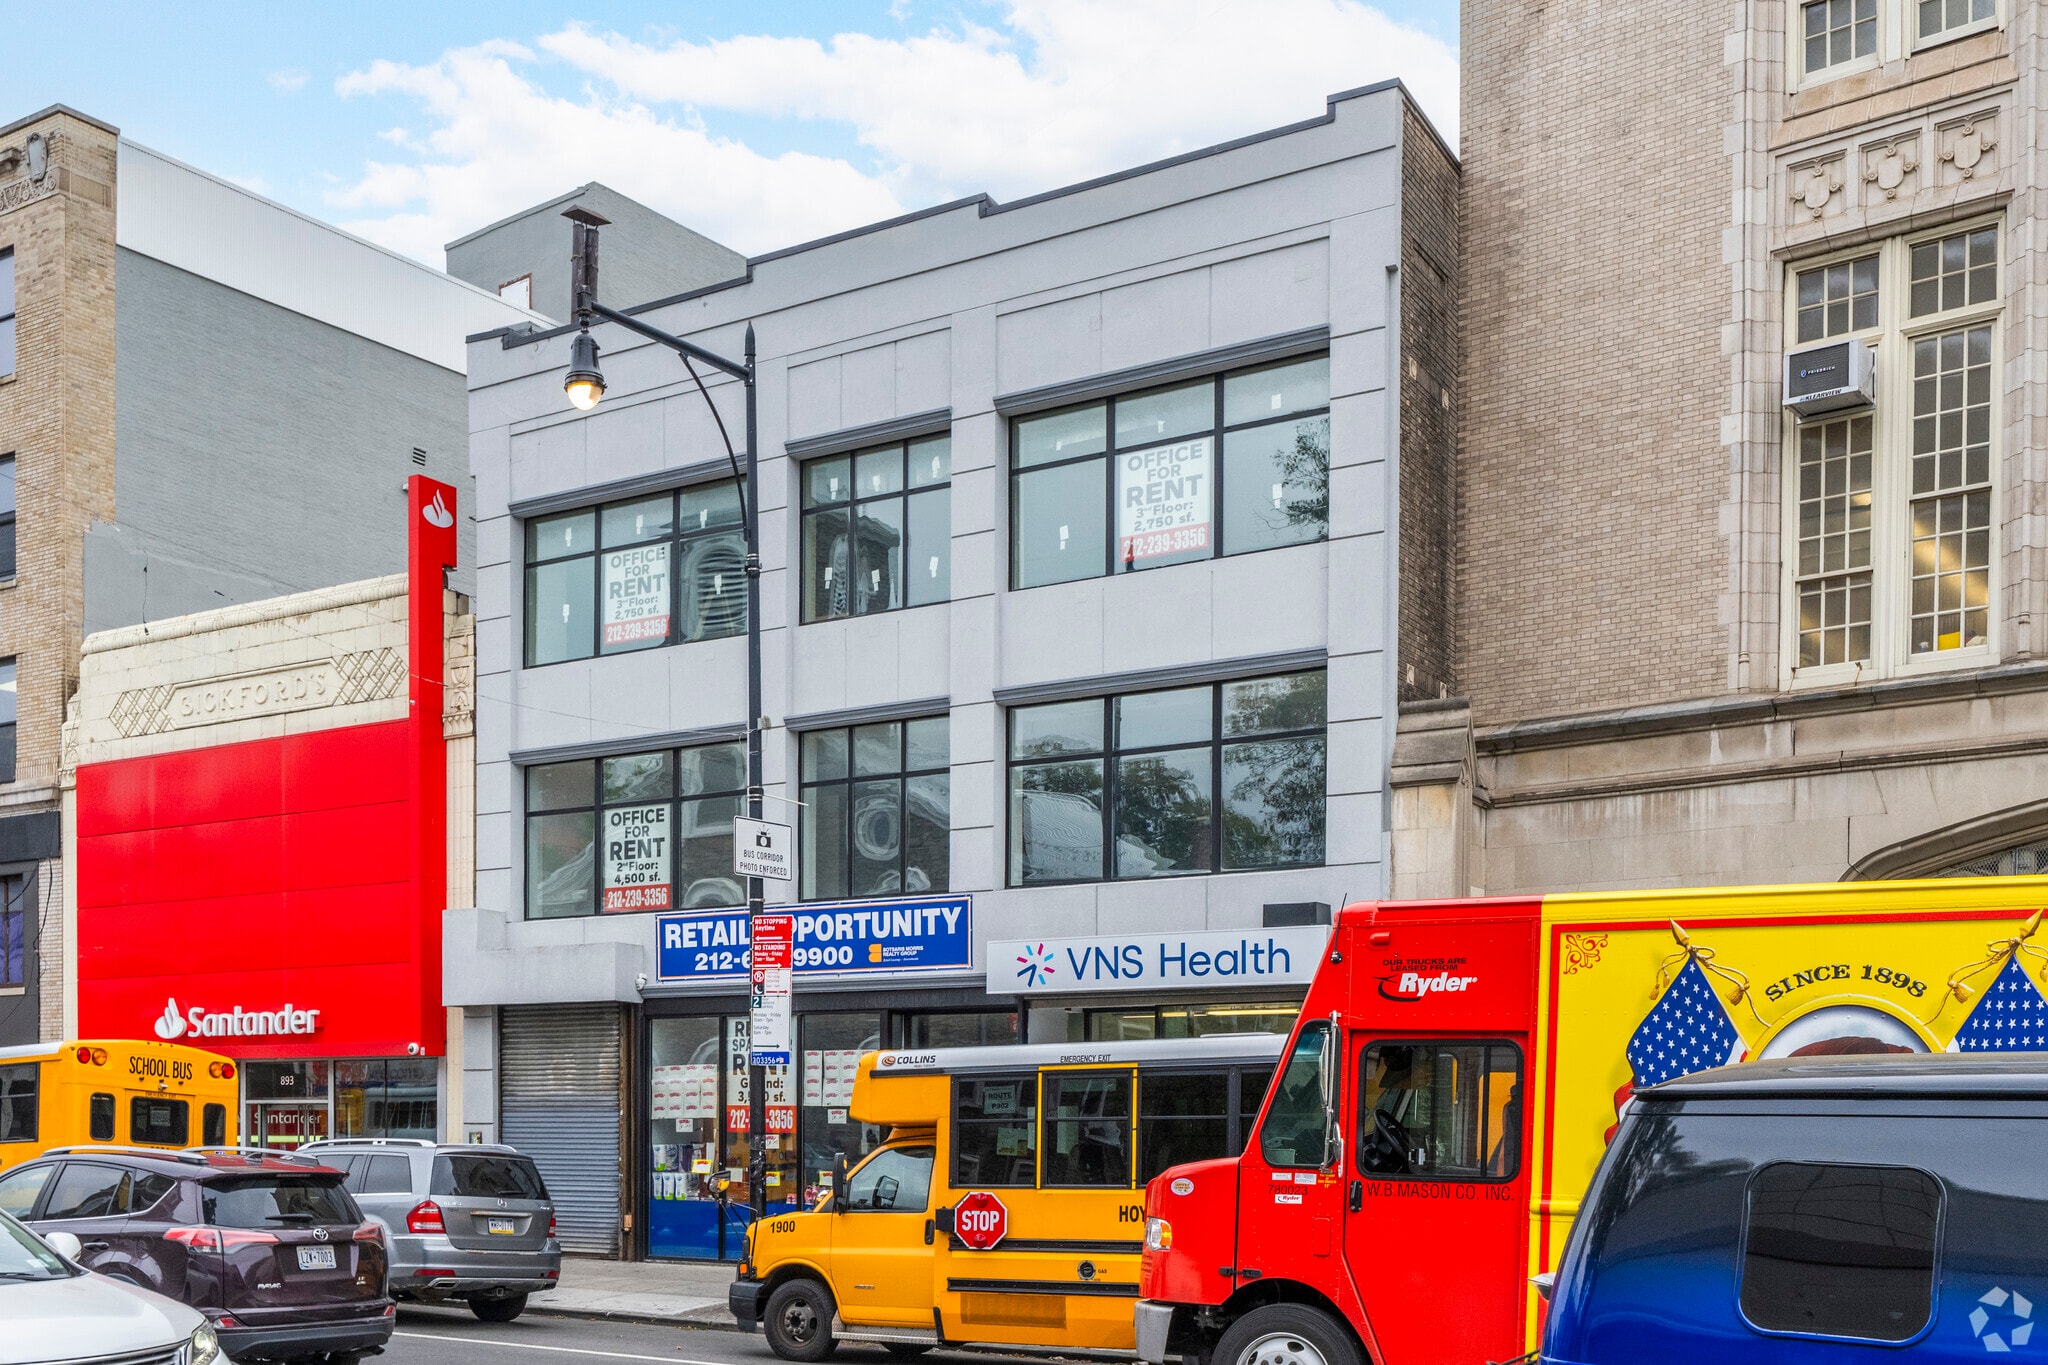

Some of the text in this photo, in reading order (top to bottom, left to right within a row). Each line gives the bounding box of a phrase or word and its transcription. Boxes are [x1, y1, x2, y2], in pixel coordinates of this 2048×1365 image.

[1808, 366, 1836, 374] FRIEDRICH
[1806, 389, 1842, 400] KLEARVIEW
[1127, 443, 1203, 472] OFFICE
[1147, 464, 1181, 482] FOR
[1126, 474, 1203, 508] RENT
[1153, 501, 1194, 516] Floor:
[1134, 511, 1196, 532] 2,750 sf.
[1123, 527, 1206, 559] 212-239-3356
[610, 547, 666, 569] OFFICE
[625, 564, 650, 578] FOR
[609, 573, 665, 600] RENT
[629, 596, 659, 607] Floor:
[615, 607, 644, 621] 2,750
[607, 618, 667, 642] 212-239-3356
[610, 807, 665, 827] OFFICE
[624, 825, 650, 839] FOR
[609, 837, 665, 861] RENT
[743, 849, 784, 863] BUS CORRIDOR
[629, 860, 659, 871] Floor:
[739, 861, 788, 876] PHOTO ENFORCED
[614, 870, 661, 886] 4,500 sf.
[607, 887, 667, 909] 212-239-3356
[665, 906, 962, 949] RETAIL PORTUNITY
[754, 925, 776, 933] Anytime
[1066, 938, 1291, 981] VNS Health
[1430, 963, 1459, 971] FROM
[1398, 971, 1472, 997] Ryder
[1765, 964, 1928, 1002] SINCE 1898
[753, 996, 760, 1008] 2
[187, 1003, 321, 1038] Santander
[896, 1054, 936, 1065] COLLINS
[1060, 1053, 1111, 1064] EMERGENCY EXIT
[129, 1056, 193, 1080] SCHOOL BUS
[279, 1075, 295, 1086] 893
[773, 1091, 786, 1102] sf.
[730, 1109, 793, 1129] 212--3356
[1267, 1184, 1309, 1196] 780023
[1367, 1181, 1515, 1201] W.B.MASON CO. INC.
[770, 1220, 796, 1233] 1900
[961, 1210, 1001, 1231] STOP
